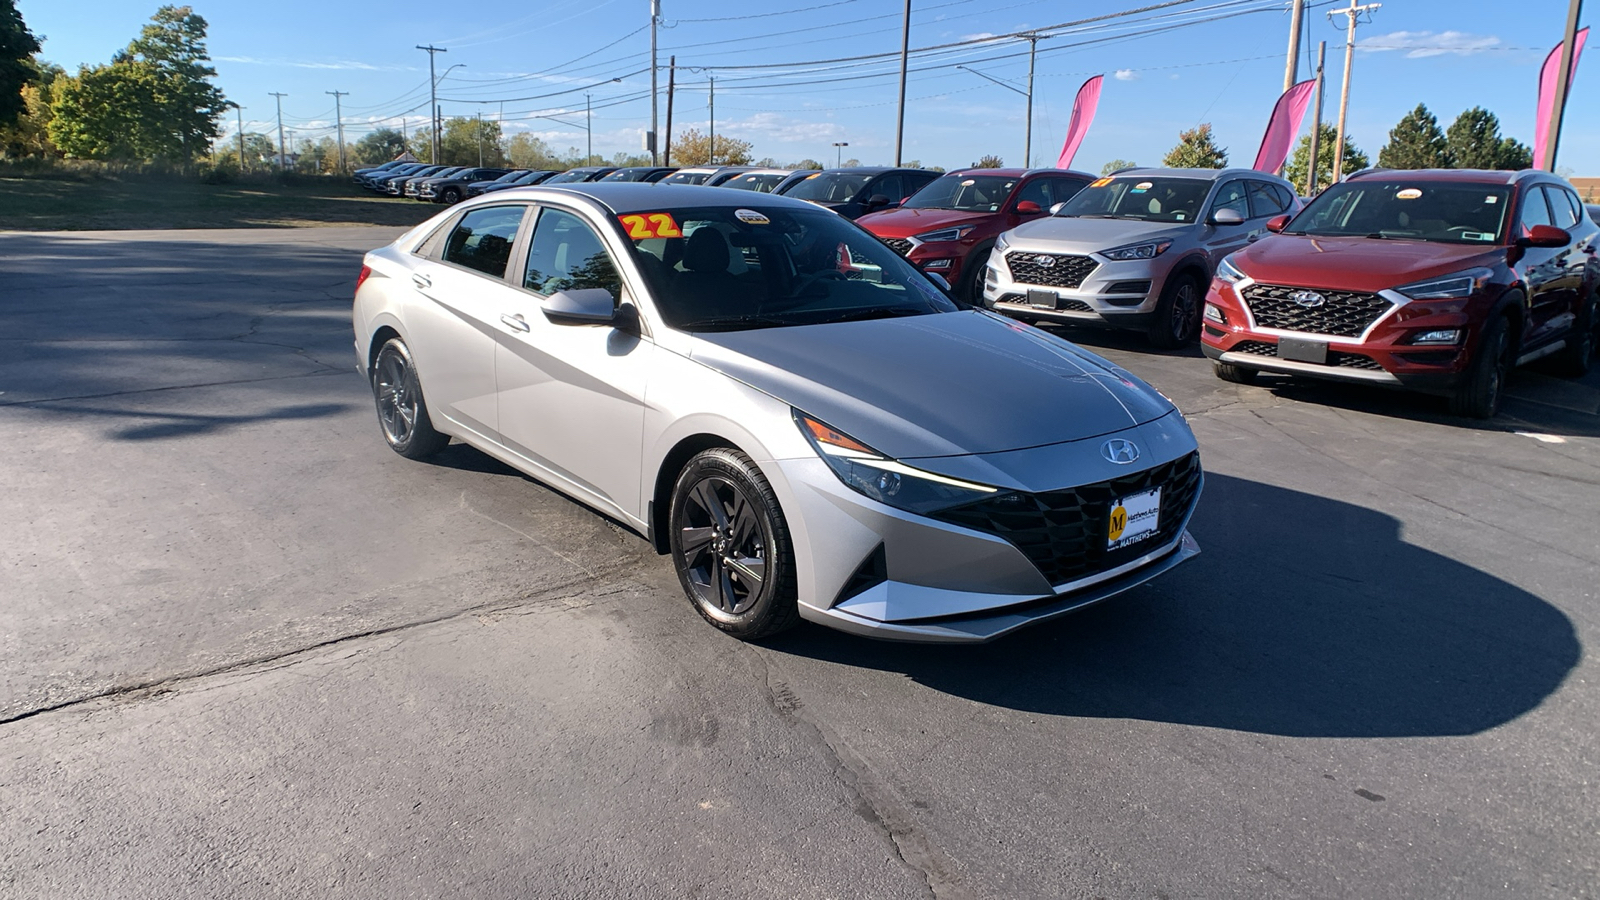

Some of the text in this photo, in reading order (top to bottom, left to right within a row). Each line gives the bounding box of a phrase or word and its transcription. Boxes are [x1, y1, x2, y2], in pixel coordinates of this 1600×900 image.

[622, 214, 679, 238] 22
[1110, 513, 1125, 534] M
[1120, 531, 1150, 548] MATTHEWS
